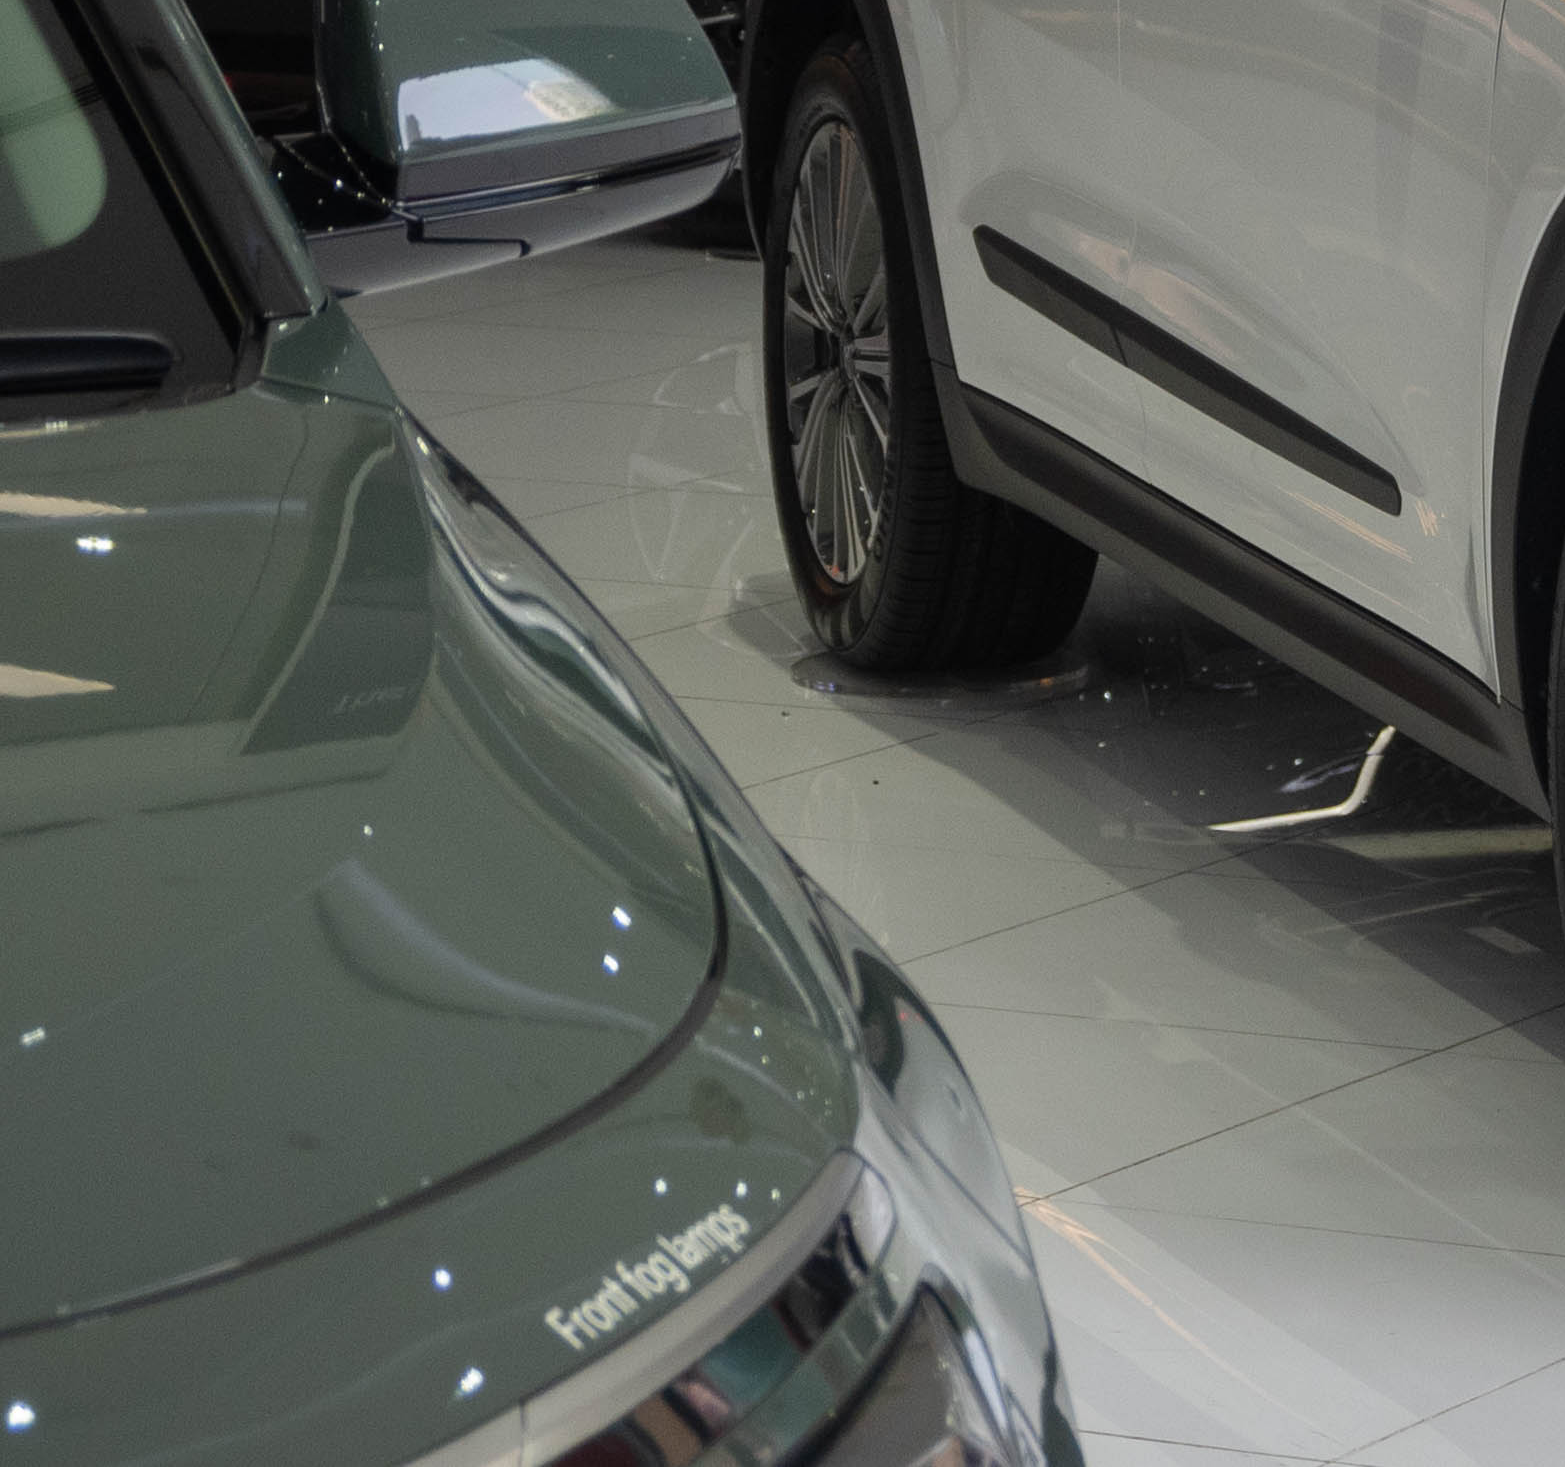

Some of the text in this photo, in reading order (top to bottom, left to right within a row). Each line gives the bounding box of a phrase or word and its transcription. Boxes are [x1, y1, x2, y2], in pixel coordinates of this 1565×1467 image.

[545, 1203, 751, 1352] Front fog lamps
